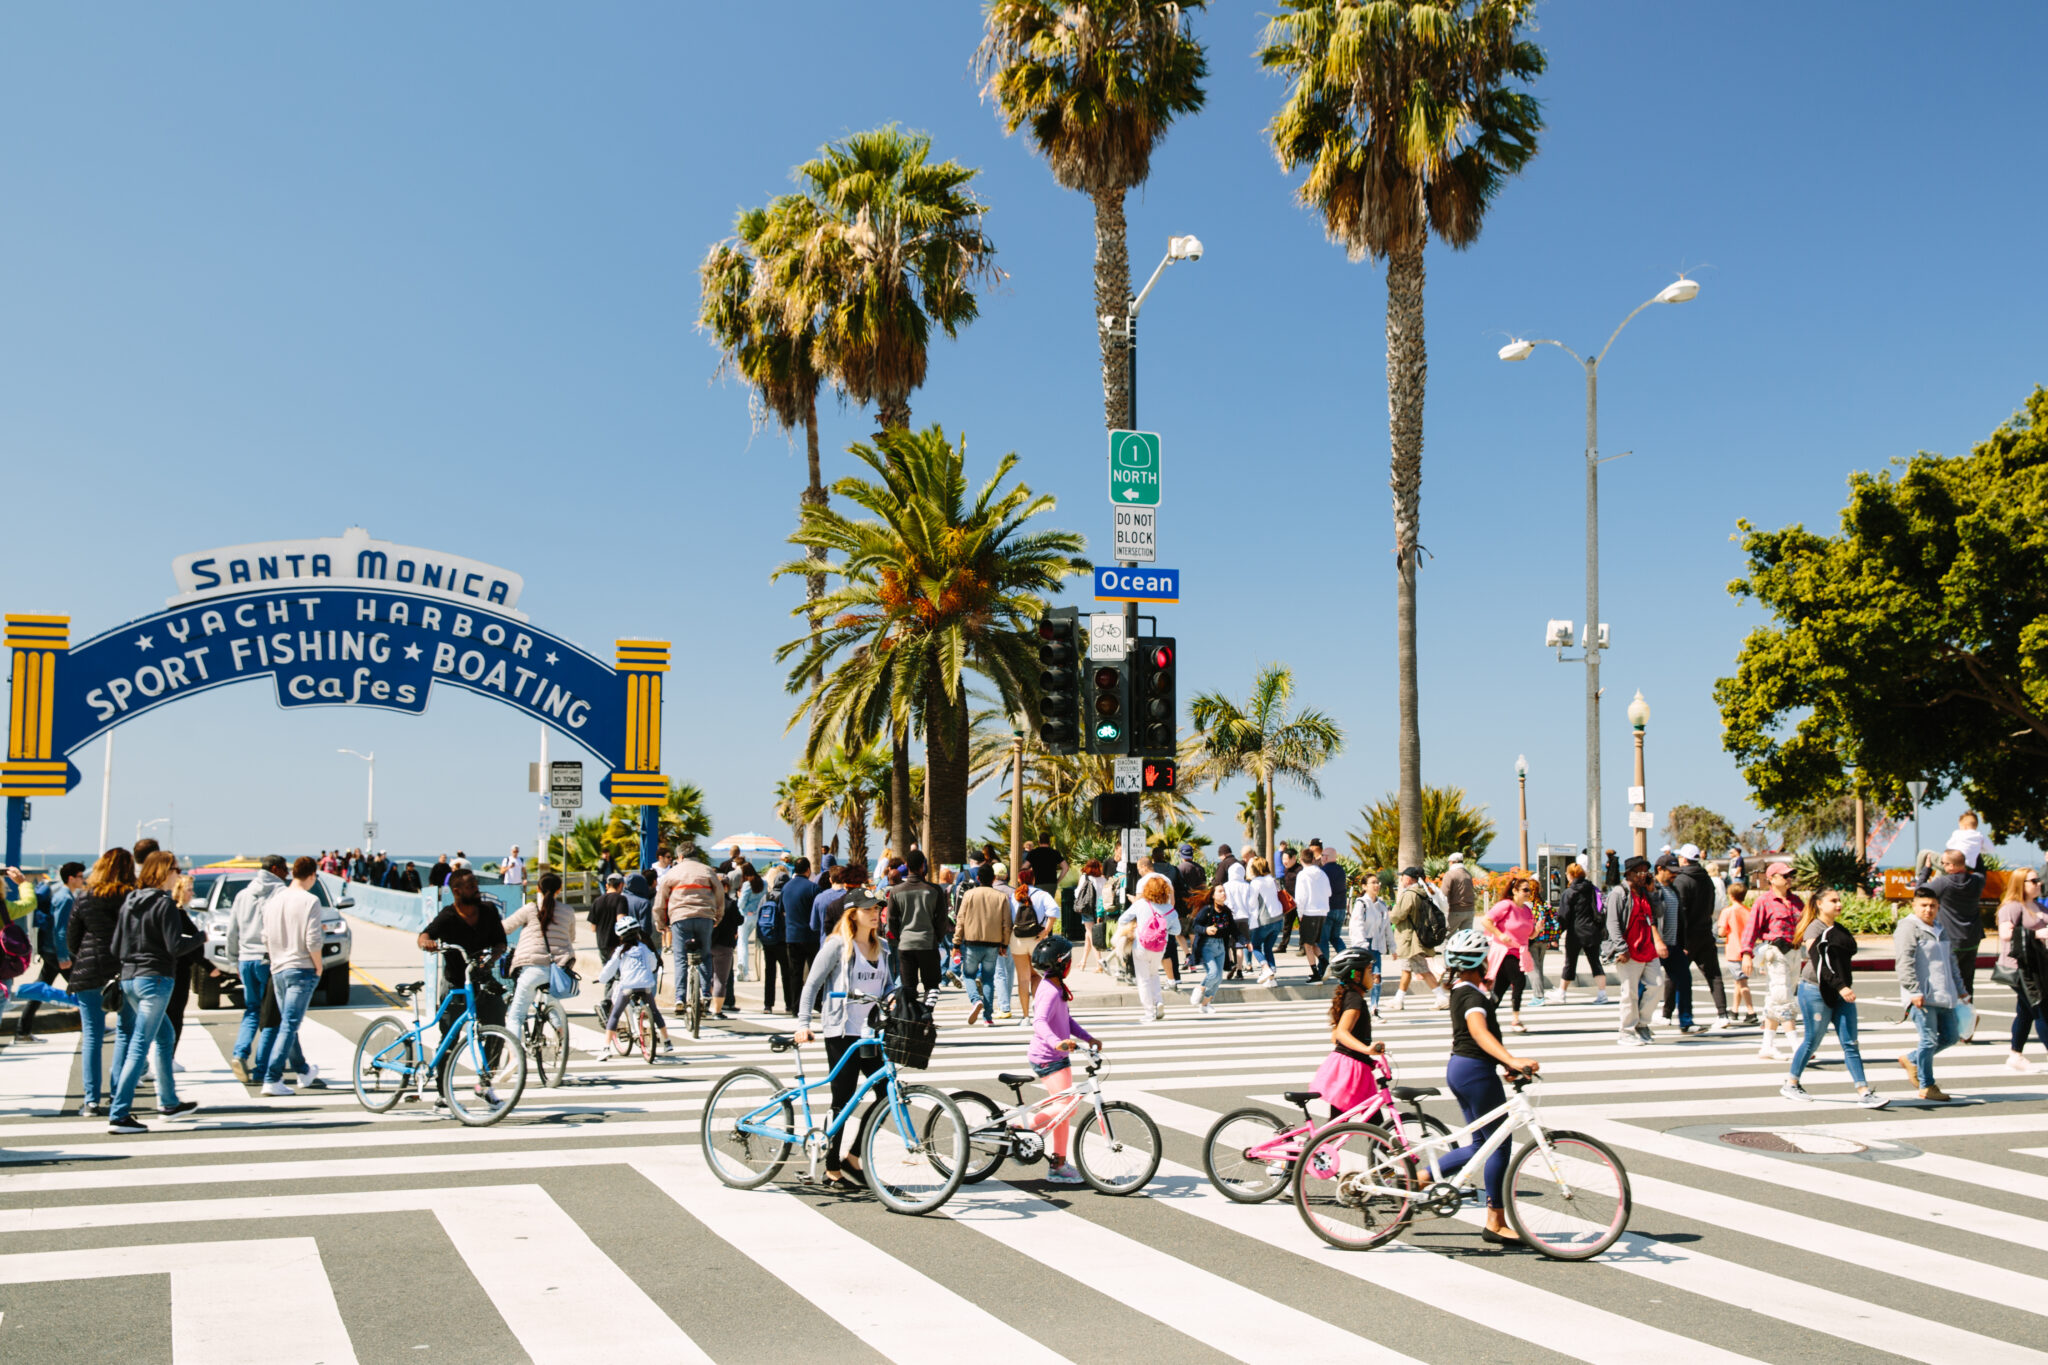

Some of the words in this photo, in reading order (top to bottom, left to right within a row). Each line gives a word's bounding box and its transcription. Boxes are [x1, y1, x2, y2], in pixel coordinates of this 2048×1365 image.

[1132, 445, 1138, 462] 1
[1113, 469, 1157, 485] NORTH
[1117, 512, 1131, 526] DO
[1134, 513, 1153, 527] NOT
[1117, 530, 1153, 545] BLOCK
[1116, 546, 1153, 557] INTERSECTION
[191, 553, 332, 591] SANTA
[356, 549, 510, 605] MONICA
[1101, 570, 1173, 592] Ocean
[166, 597, 322, 643] YACHT
[356, 598, 534, 659] HARBOR
[1093, 643, 1122, 653] SIGNAL
[86, 646, 210, 722] SPORT
[230, 630, 391, 672] FISHING
[432, 641, 592, 729] BOATING
[1116, 776, 1126, 788] OK
[1166, 767, 1173, 786] 3
